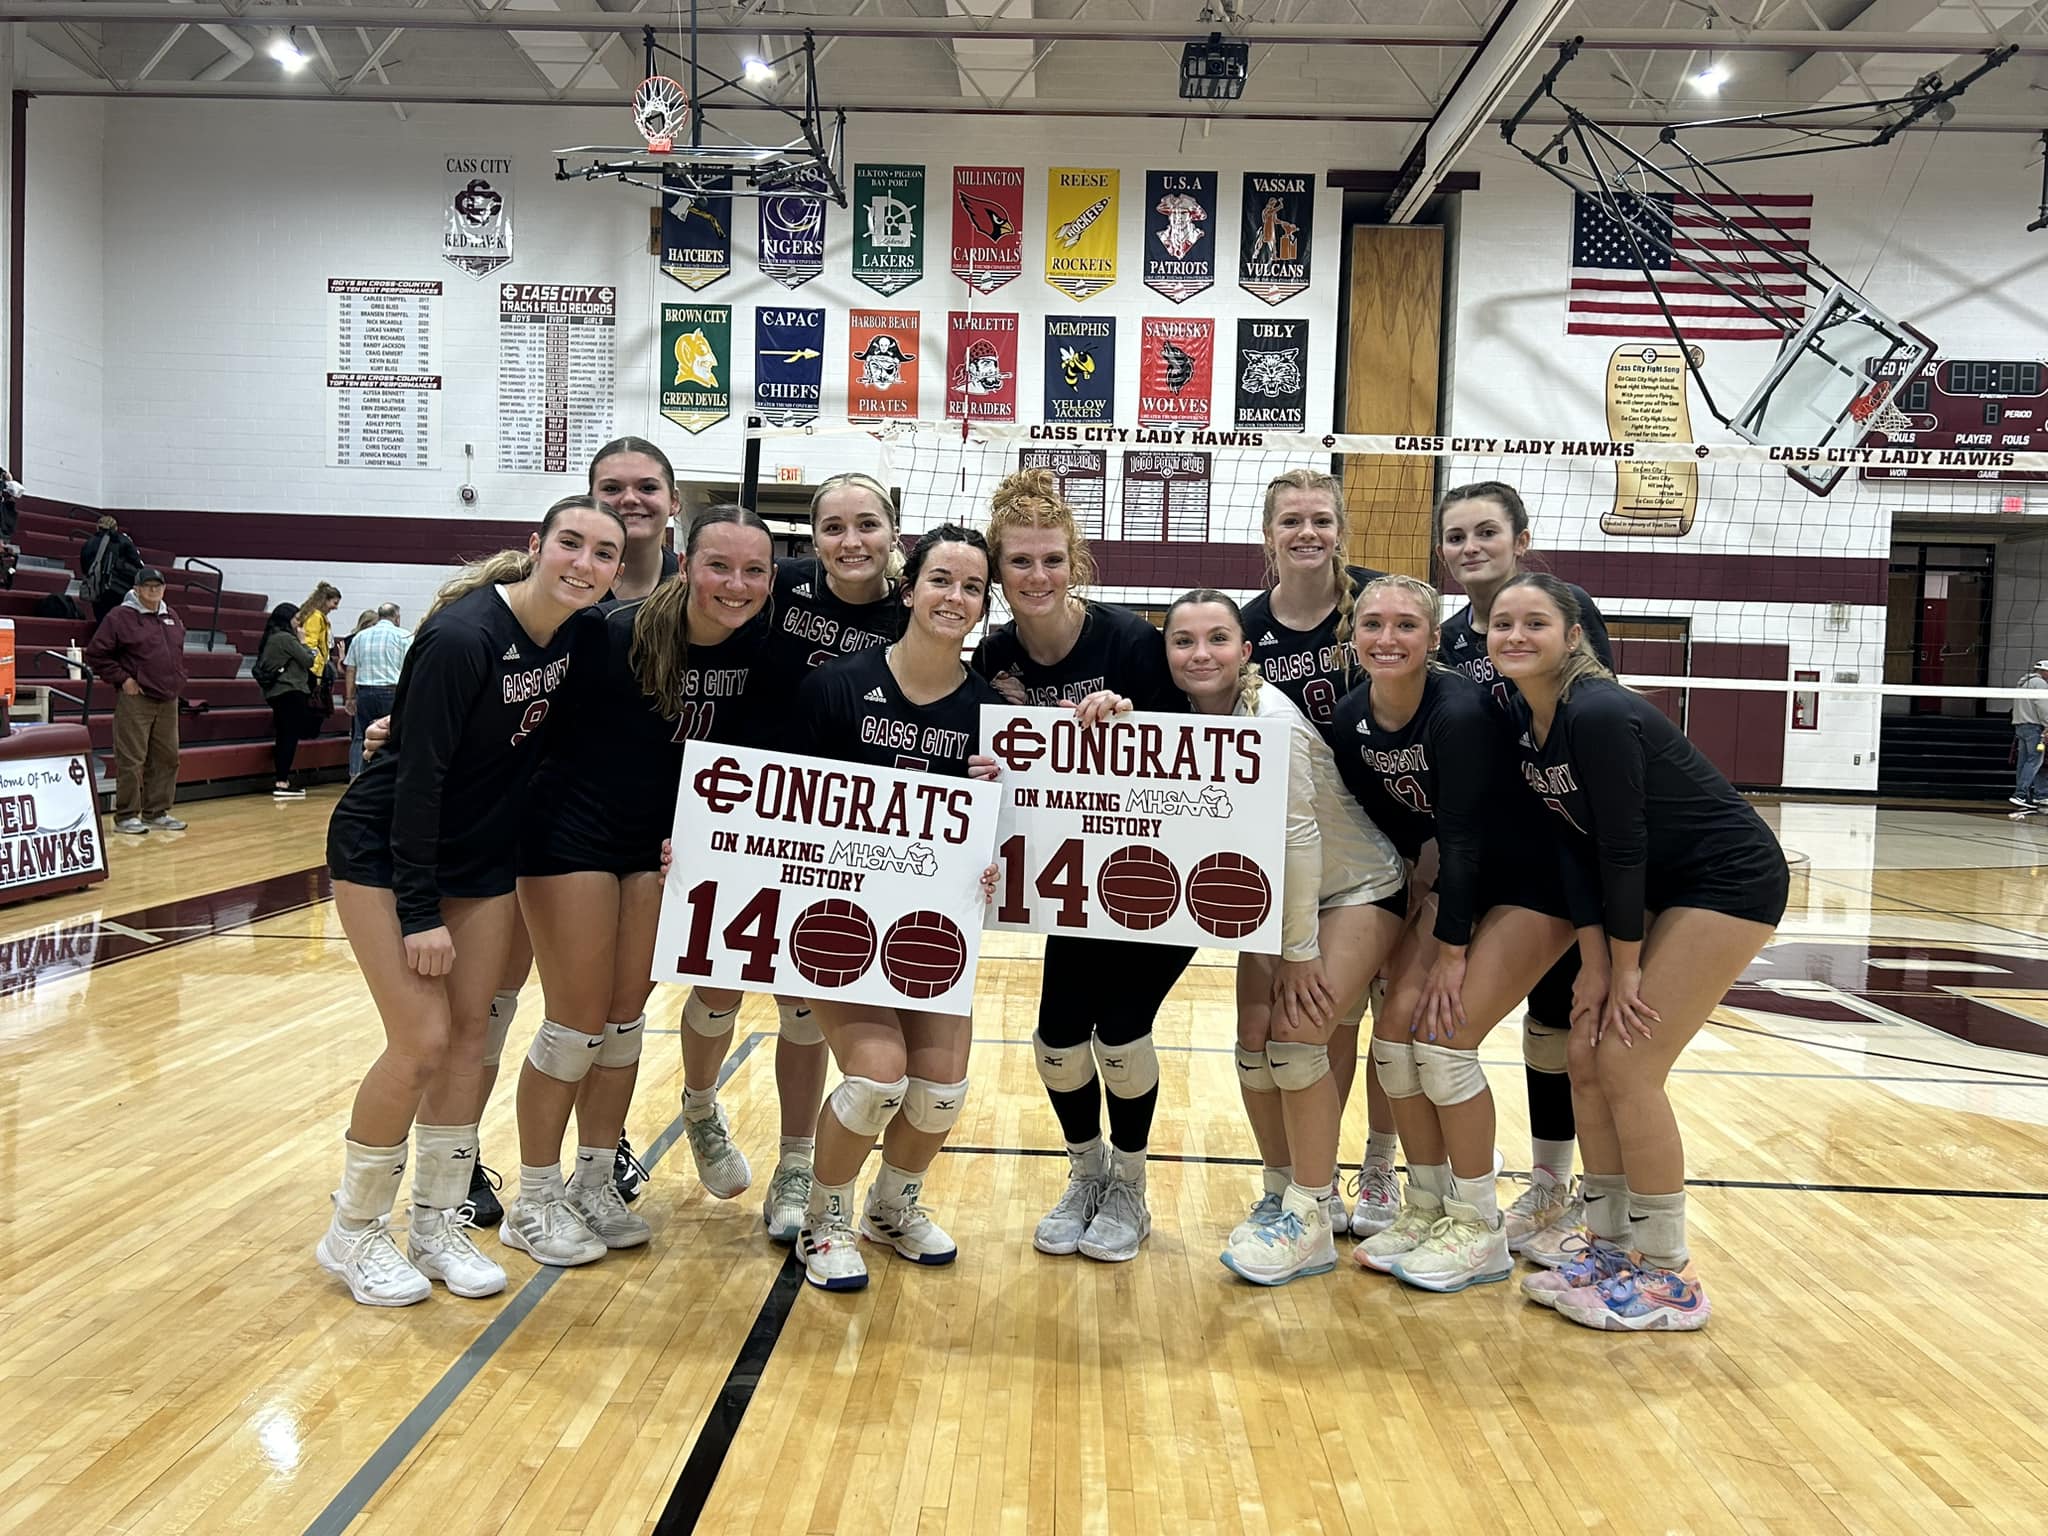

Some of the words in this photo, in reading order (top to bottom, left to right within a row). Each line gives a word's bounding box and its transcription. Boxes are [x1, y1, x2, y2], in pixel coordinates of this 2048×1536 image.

[446, 158, 477, 173] CASS
[480, 159, 511, 174] CITY
[857, 169, 889, 178] ELKTON
[894, 170, 923, 178] PIGEON
[871, 179, 887, 187] BAY
[888, 179, 908, 187] PORT
[956, 171, 1022, 186] MILLINGTON
[1060, 174, 1109, 187] REESE
[1163, 176, 1202, 190] U.S.A
[1253, 178, 1305, 193] VASSAR
[1066, 201, 1105, 238] ROCKETS
[445, 233, 467, 248] RED
[761, 239, 823, 255] TIGERS
[668, 248, 725, 263] HATCHETS
[862, 254, 915, 268] LAKERS
[953, 246, 1020, 263] CARDINALS
[1052, 257, 1112, 271] ROCKETS
[1150, 261, 1208, 275] PATRIOTS
[1246, 263, 1304, 277] VULCANS
[521, 285, 560, 301] CASS
[561, 287, 595, 302] CITY
[501, 301, 533, 312] TRACK
[534, 302, 539, 312] &
[540, 301, 567, 313] FIELD
[569, 303, 613, 314] RECORDS
[665, 309, 701, 323] BROWN
[704, 310, 728, 323] CITY
[762, 311, 819, 327] CAPAC
[851, 315, 888, 329] HARBOR
[889, 316, 917, 329] BEACH
[1048, 322, 1110, 337] MEMPHIS
[1145, 321, 1211, 339] SANDUSKY
[1252, 324, 1295, 338] UBLY
[1646, 365, 1662, 373] Fight
[1663, 366, 1680, 374] Song
[758, 383, 819, 399] CHIEFS
[663, 392, 695, 405] GREEN
[695, 393, 727, 406] DEVILS
[859, 399, 908, 412] PIRATES
[1051, 399, 1107, 409] YELLOW
[1141, 398, 1208, 413] WOLVES
[970, 401, 1011, 415] RAIDERS
[1055, 408, 1101, 418] JACKETS
[1239, 408, 1301, 422] BEARCATS
[2004, 410, 2032, 418] PERIOD
[1030, 426, 1077, 440] CASS
[1084, 428, 1128, 442] CITY
[1135, 430, 1185, 444] LADY
[1192, 431, 1263, 447] HAWKS
[1888, 432, 1916, 443] FOULS
[1955, 434, 1992, 444] PLAYER
[2001, 435, 2030, 445] FOULS
[1394, 436, 1444, 451] CASS
[1451, 437, 1499, 452] CITY
[1503, 440, 1556, 455] LADY
[1560, 441, 1635, 457] HAWKS
[1024, 453, 1049, 470] STATE
[1051, 453, 1100, 472] CHAMPIONS
[1768, 445, 1820, 461] CASS
[1827, 447, 1873, 463] CITY
[1879, 449, 1933, 465] LADY
[1939, 451, 2015, 467] HAWKS
[1154, 457, 1180, 471] POINT
[1182, 457, 1204, 474] CLUB
[1889, 469, 1908, 477] WON
[781, 468, 797, 481] EXIT
[1977, 470, 1999, 478] GAME
[783, 606, 839, 646] CASS
[1264, 651, 1316, 683] CASS
[503, 668, 543, 704] CASS
[703, 668, 749, 697] CITY
[863, 694, 887, 704] adidas
[1302, 678, 1338, 724] 8
[670, 701, 715, 743] 11
[861, 715, 918, 751] CASS
[921, 727, 970, 760] CITY
[27, 772, 40, 789] Of
[41, 771, 62, 785] The
[1014, 788, 1039, 808] ON
[1045, 789, 1121, 813] MAKING
[0, 794, 38, 839] ED
[1081, 814, 1162, 838] HISTORY
[710, 830, 740, 852] ON
[744, 834, 825, 864] MAKING
[779, 864, 865, 893] HISTORY
